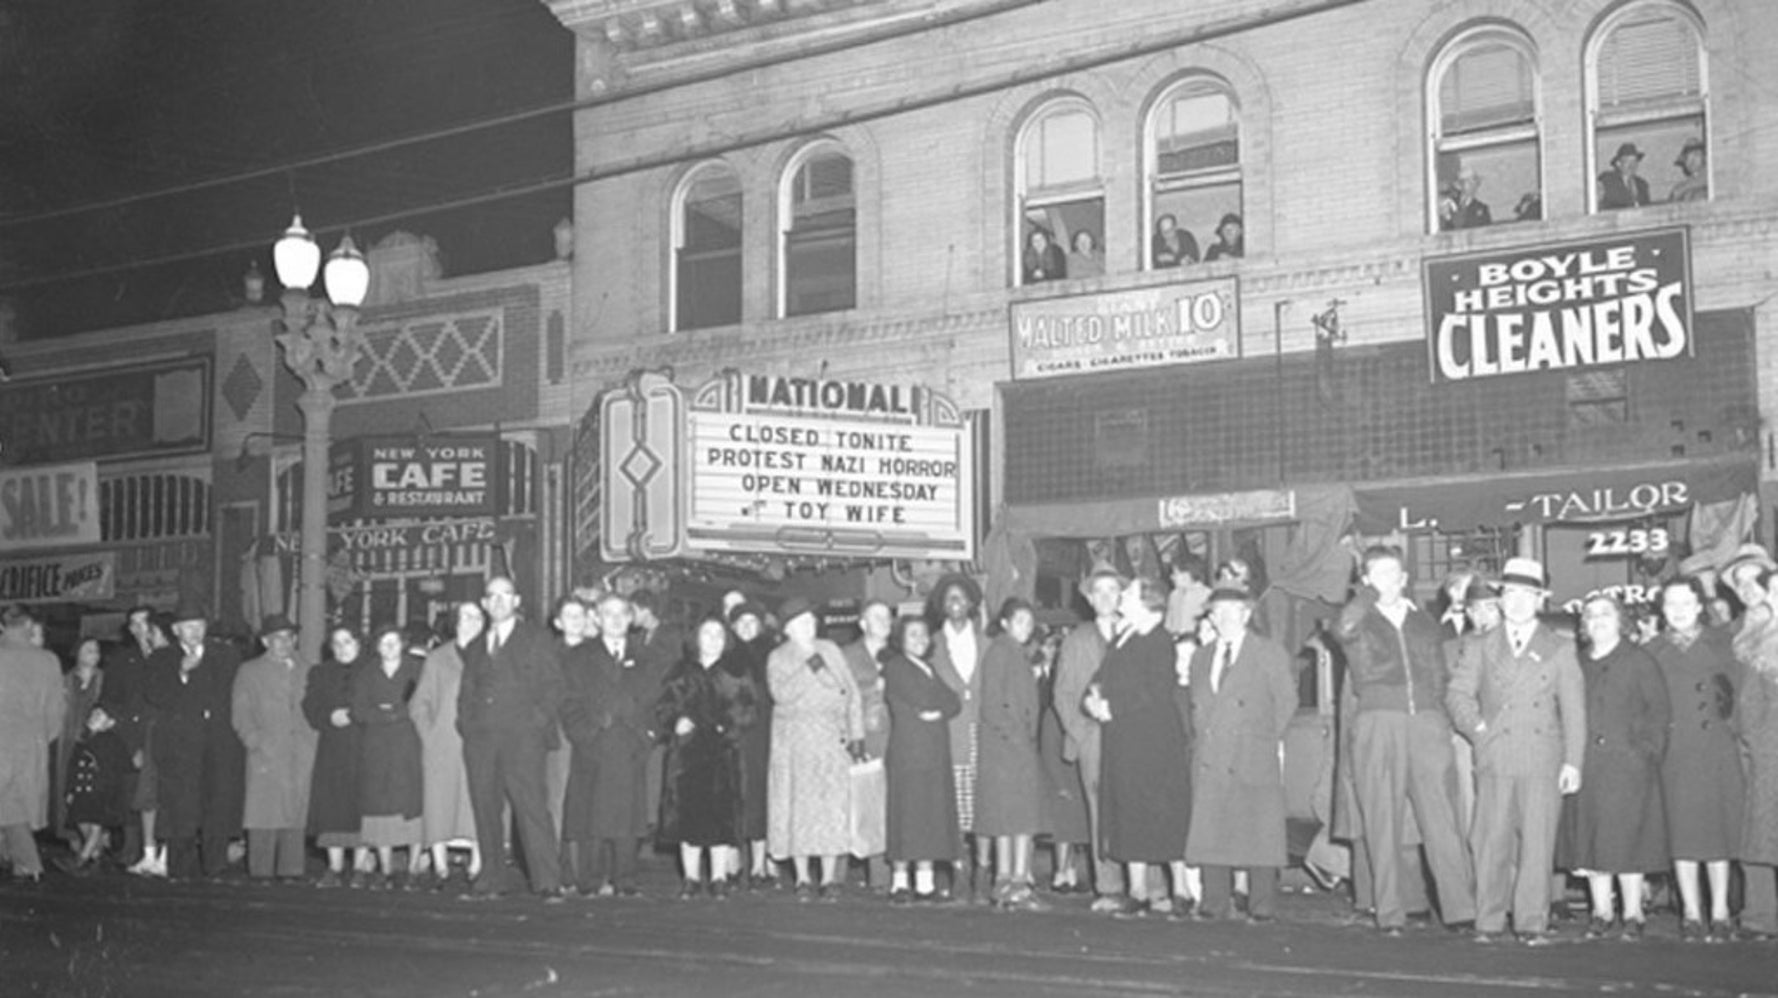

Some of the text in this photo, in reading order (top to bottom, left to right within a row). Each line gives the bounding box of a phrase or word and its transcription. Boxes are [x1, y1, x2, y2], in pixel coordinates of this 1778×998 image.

[1479, 246, 1635, 285] BOYLE
[1455, 269, 1658, 312] HEIGHTS
[1017, 314, 1103, 349] MALTED
[1113, 309, 1171, 341] MILK
[1438, 282, 1685, 379] CLEANERS
[749, 376, 909, 413] NATIONAL
[730, 424, 913, 452] CLOSED TONITE
[373, 447, 485, 460] NEW YORK
[708, 447, 956, 478] PROTEST NAZI HORROR
[372, 462, 486, 489] CAFE
[742, 474, 938, 501] OPEN WEDNESDAY
[0, 472, 88, 541] SALE!
[386, 491, 486, 505] RESTAURANT
[1400, 507, 1438, 529] L.
[1531, 481, 1688, 519] TAILOR
[784, 502, 906, 524] TOY WIFE
[341, 529, 408, 550] YORK
[421, 522, 495, 544] CAFE
[1589, 528, 1670, 556] 2233
